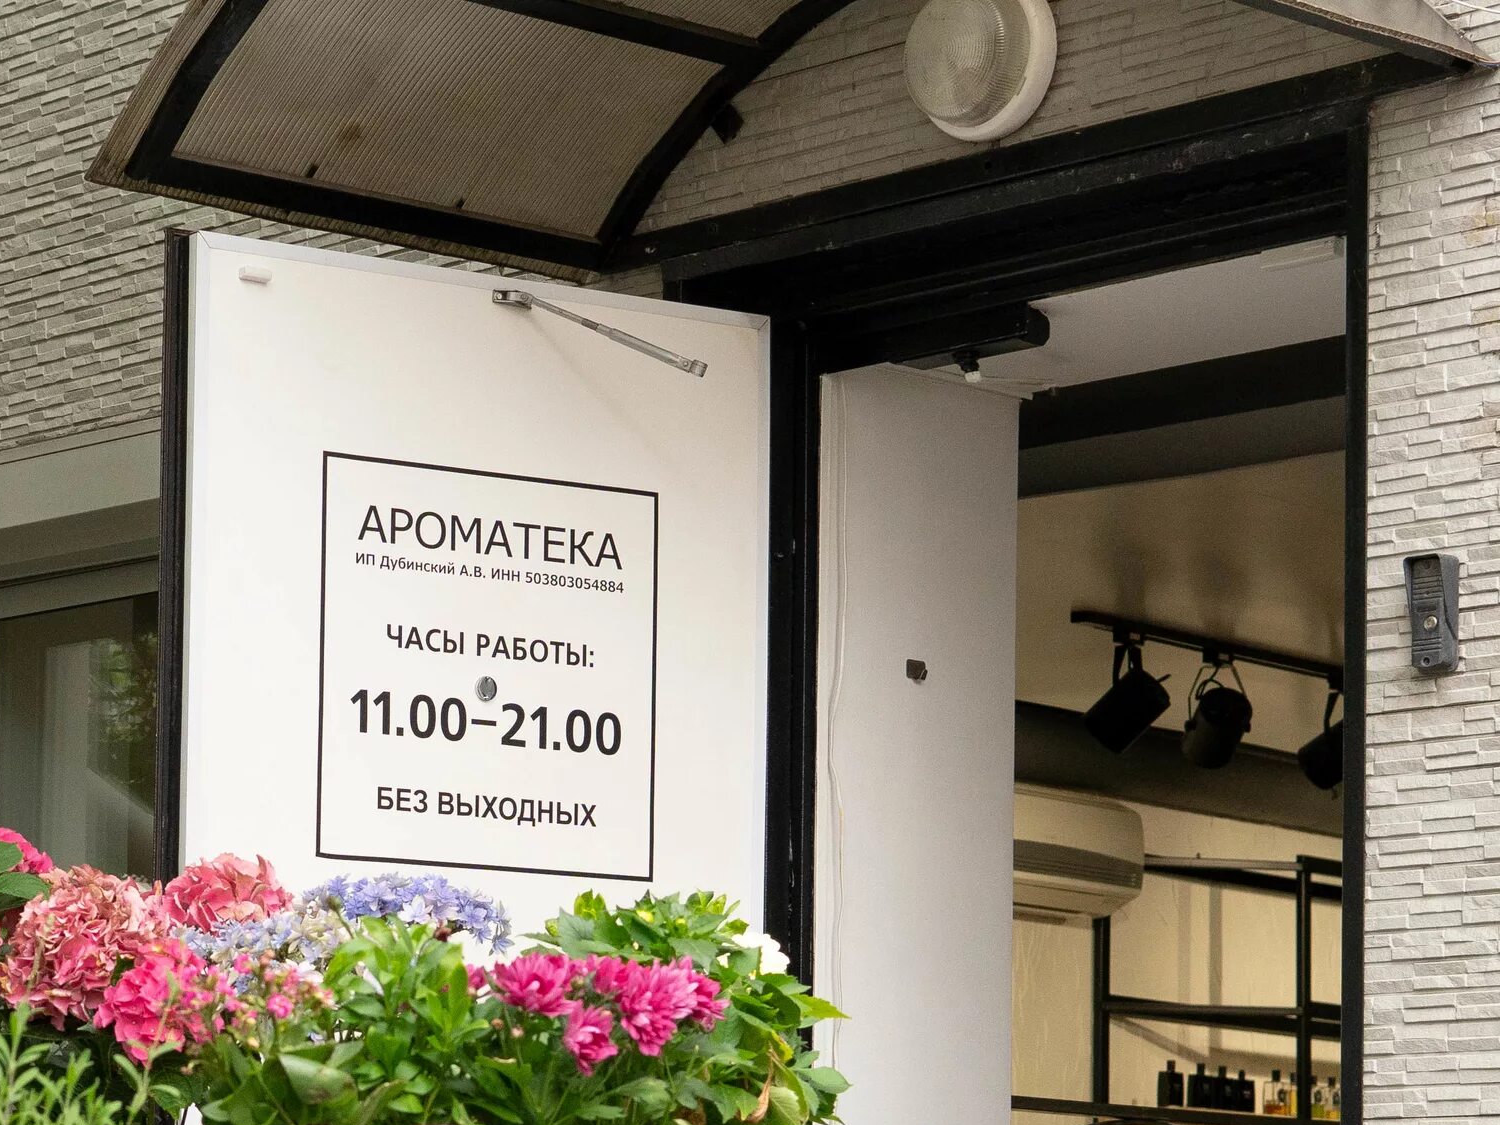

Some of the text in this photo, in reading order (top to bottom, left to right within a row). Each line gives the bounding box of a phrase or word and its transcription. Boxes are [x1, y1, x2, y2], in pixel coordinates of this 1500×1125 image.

[358, 505, 622, 570] АРОМАТЕКА
[355, 552, 624, 594] ИП Дубинский А.В. ИНН 503803054884
[387, 624, 594, 668] ЧАСЫ РАБОТЫ:
[378, 787, 596, 827] БЕЗ ВЫХОДНЫХ
